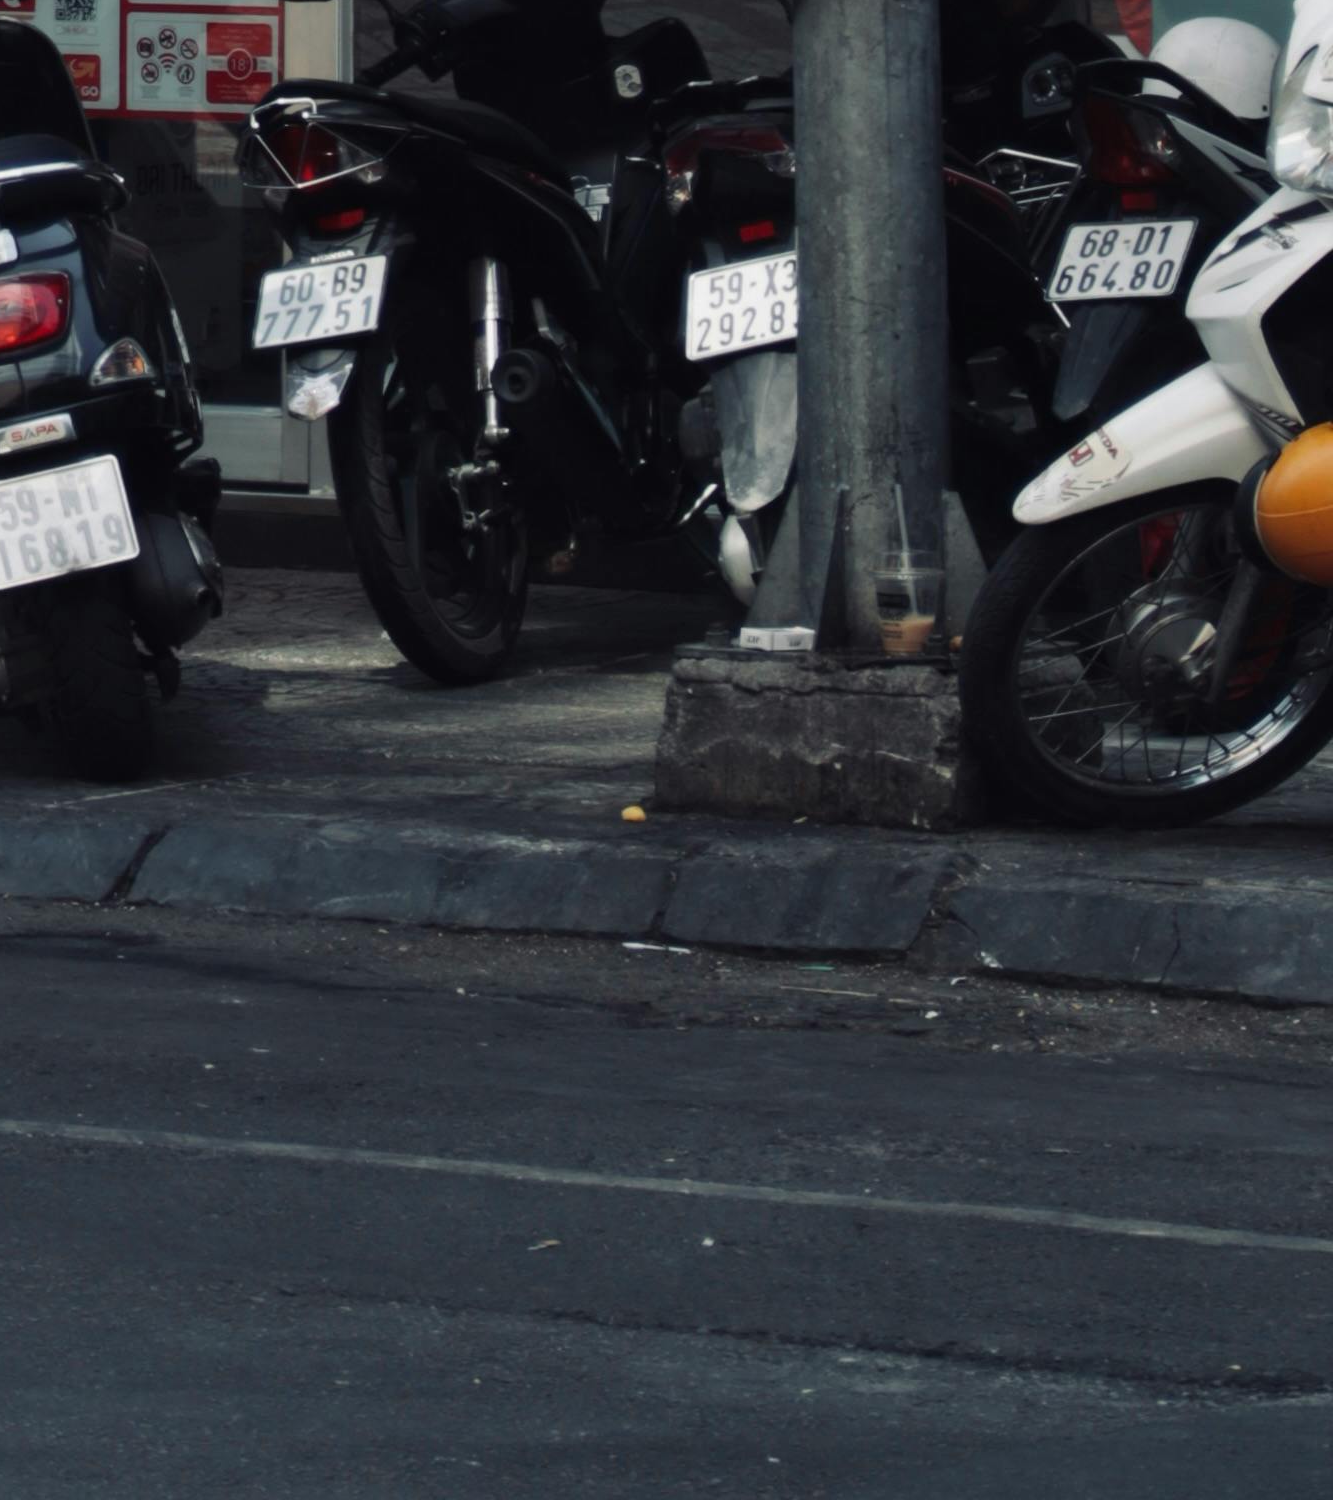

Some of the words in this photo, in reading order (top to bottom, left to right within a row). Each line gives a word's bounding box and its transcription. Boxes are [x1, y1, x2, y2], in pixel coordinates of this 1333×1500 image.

[1078, 225, 1173, 259] 68-D1
[279, 262, 368, 307] 60-B9
[708, 258, 797, 310] 59-X3
[1055, 259, 1175, 295] 664.80
[259, 294, 374, 345] 777.51
[696, 300, 797, 354] 292.8
[9, 422, 60, 444] SAPA
